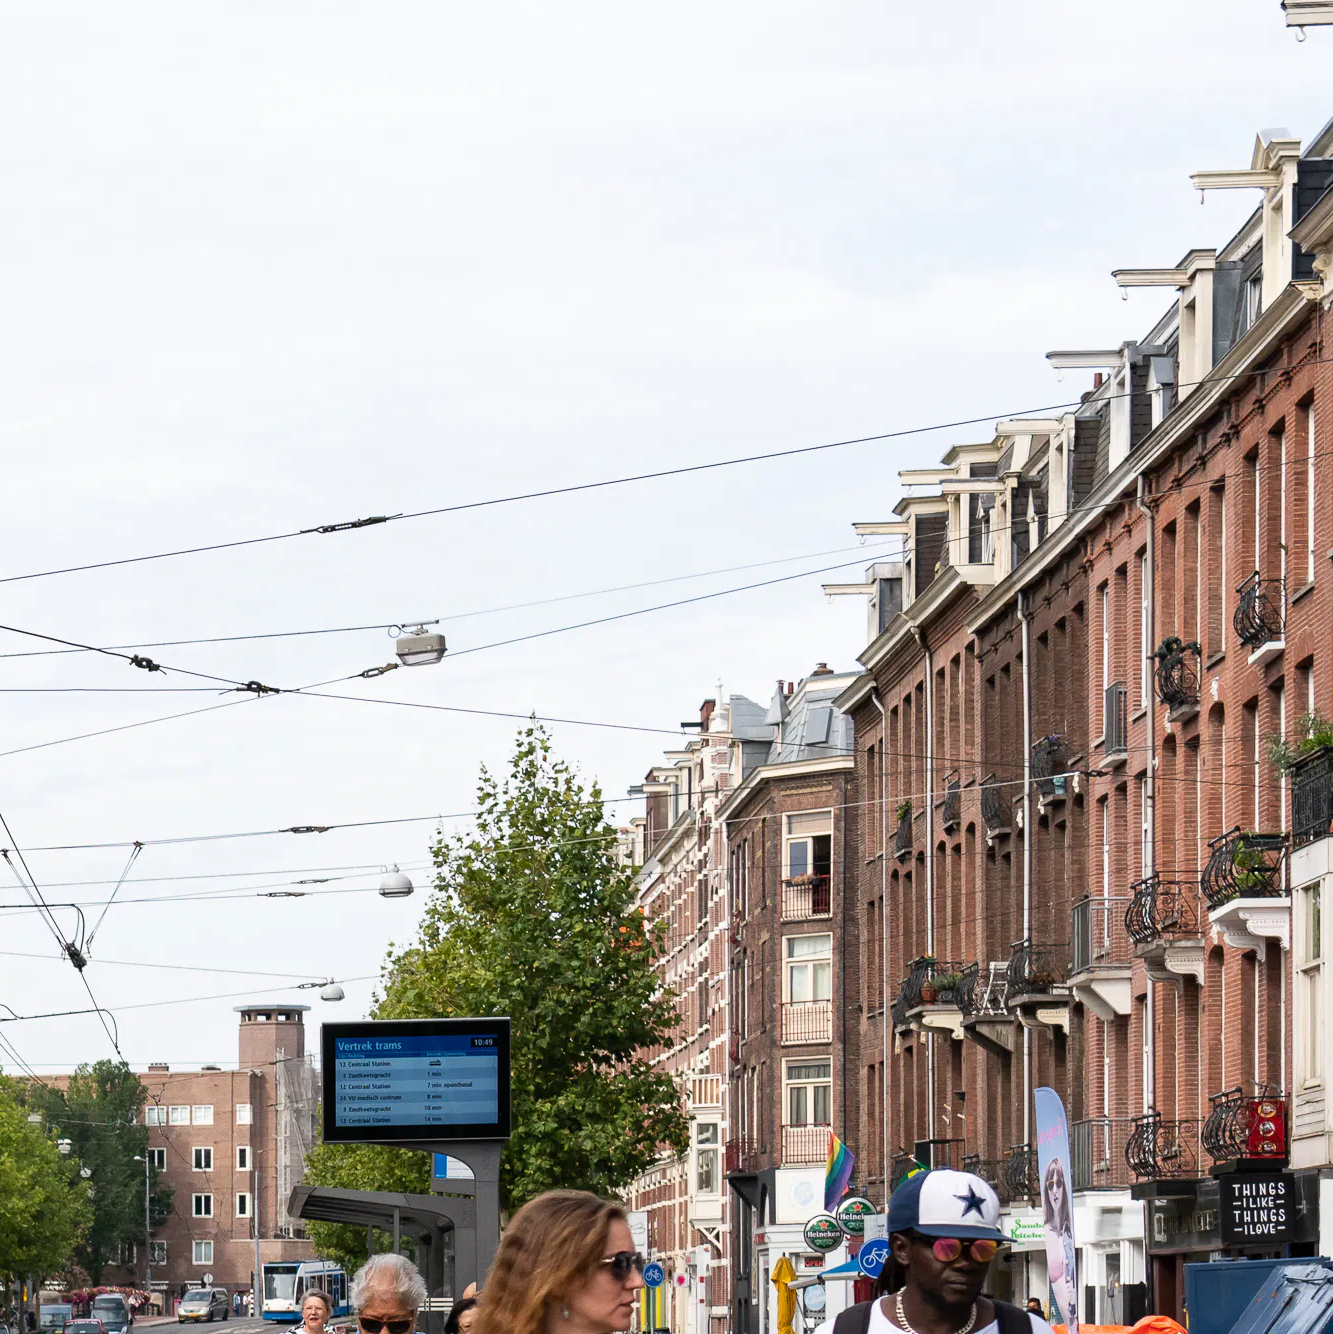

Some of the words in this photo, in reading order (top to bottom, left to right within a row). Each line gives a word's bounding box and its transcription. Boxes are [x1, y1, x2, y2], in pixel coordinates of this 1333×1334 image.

[338, 1041, 372, 1050] Vertrek
[375, 1041, 402, 1050] trams
[1232, 1182, 1286, 1197] THINGS
[1249, 1197, 1275, 1208] LIKE
[1233, 1209, 1286, 1223] THINGS
[1010, 1229, 1045, 1239] Kitche
[1249, 1223, 1276, 1235] LOVE
